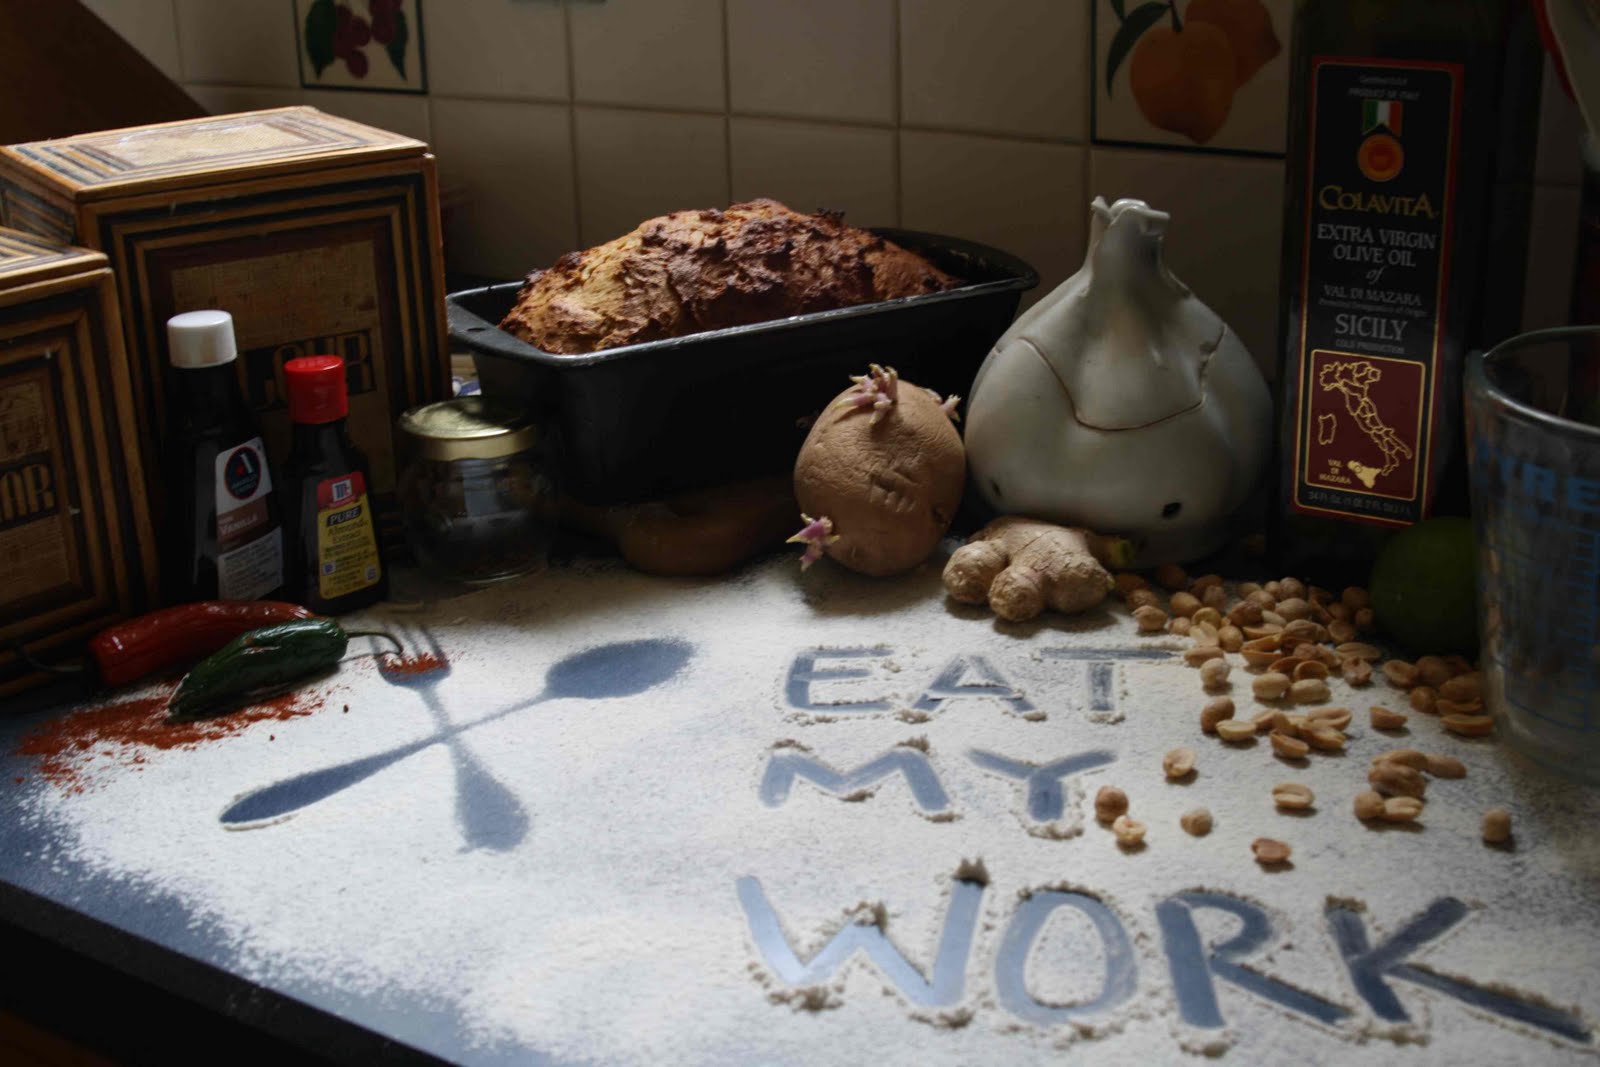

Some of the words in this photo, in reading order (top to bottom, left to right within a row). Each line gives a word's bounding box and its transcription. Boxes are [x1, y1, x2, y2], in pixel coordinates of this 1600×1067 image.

[1317, 223, 1375, 244] EXTRA
[1379, 228, 1437, 249] VIRGIN
[1333, 244, 1385, 264] OLIVE
[1388, 250, 1417, 268] OIL
[1366, 265, 1387, 285] of
[1323, 284, 1347, 299] VAL
[1350, 287, 1363, 300] DI
[1366, 289, 1422, 306] MAZARA
[1335, 313, 1408, 342] SICILY
[329, 507, 360, 525] PURE
[784, 646, 1182, 714] EAT
[758, 744, 1119, 820] MY
[736, 874, 1594, 1042] WORK
